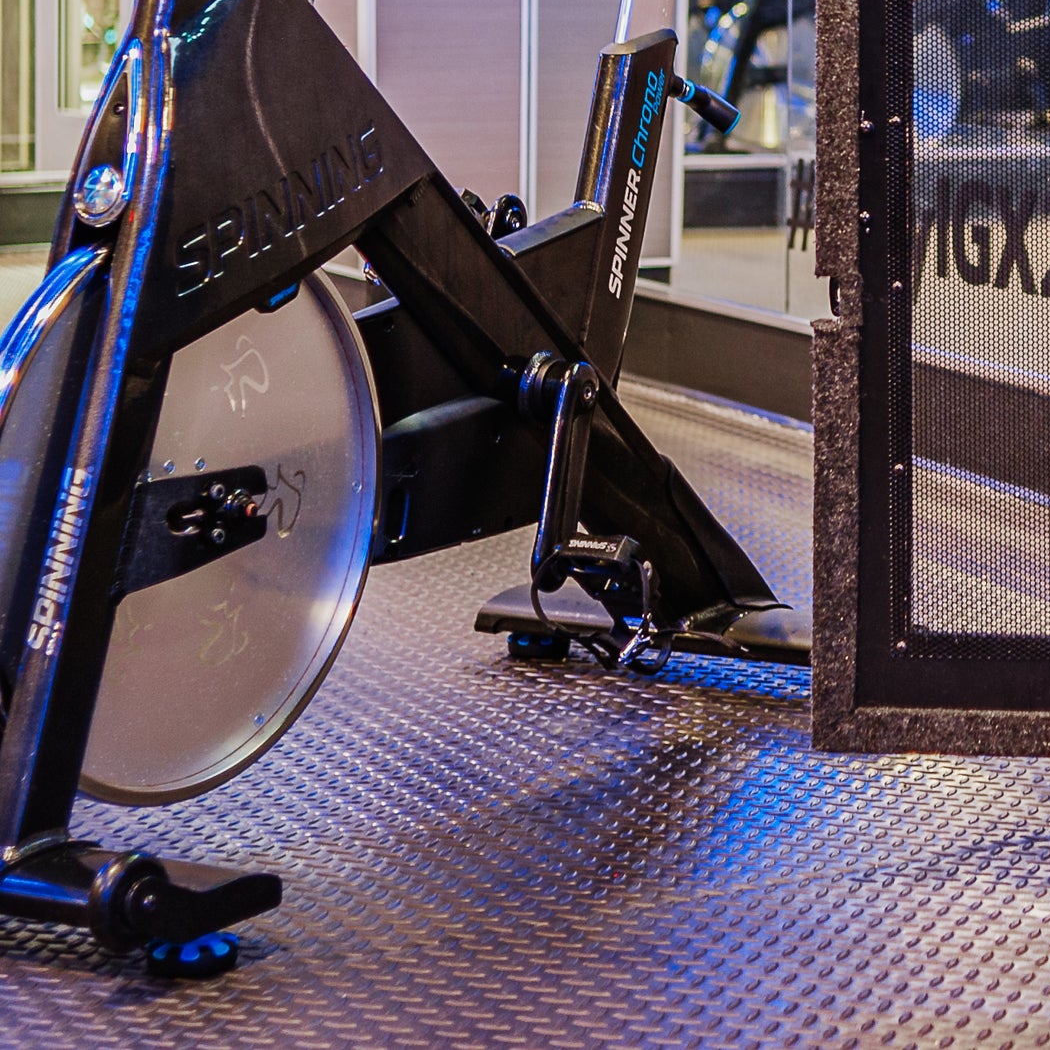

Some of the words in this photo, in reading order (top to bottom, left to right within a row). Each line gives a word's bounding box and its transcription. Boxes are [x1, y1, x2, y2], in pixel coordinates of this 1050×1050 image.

[174, 119, 384, 298] SPINNING
[608, 167, 642, 299] SPINNER
[631, 70, 659, 170] Chrono
[27, 466, 93, 650] SPINNING
